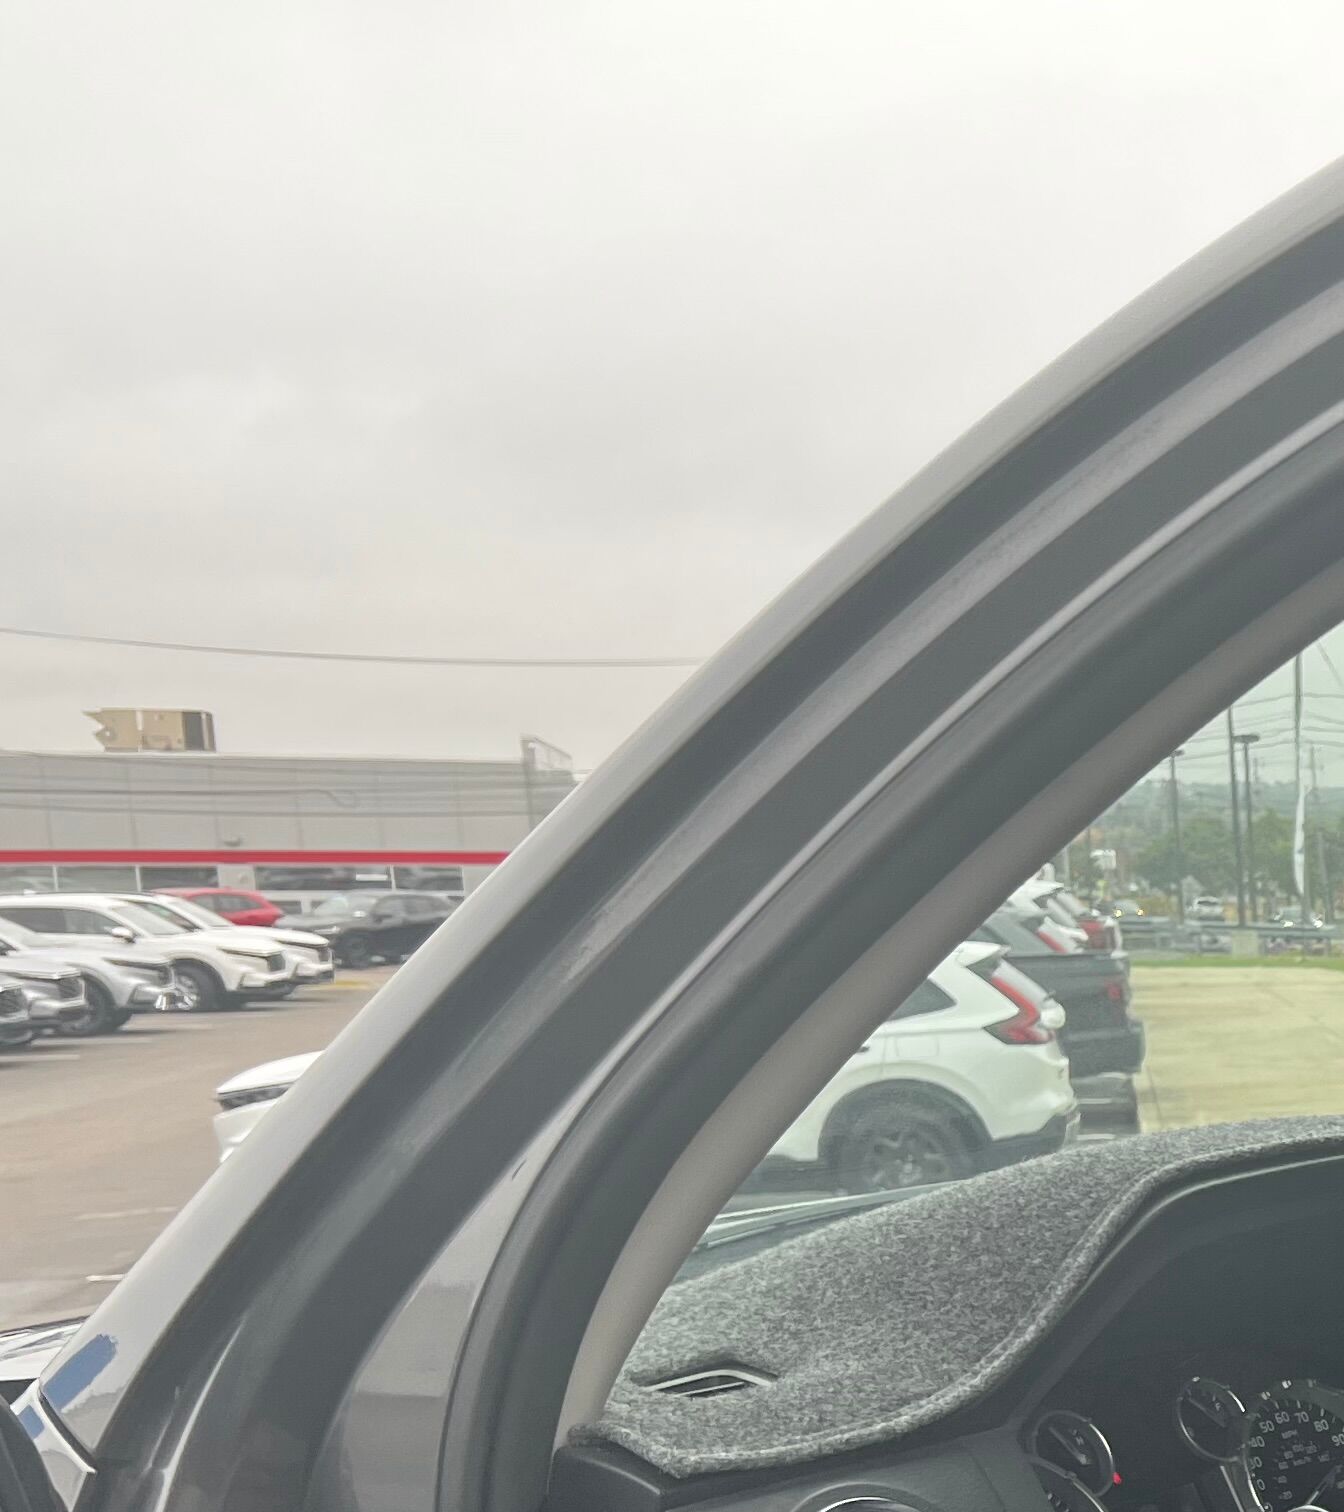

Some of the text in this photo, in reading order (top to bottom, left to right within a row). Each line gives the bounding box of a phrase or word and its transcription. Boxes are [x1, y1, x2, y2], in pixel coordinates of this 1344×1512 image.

[1274, 1411, 1290, 1424] 60
[1294, 1411, 1309, 1423] 70
[1259, 1421, 1275, 1433] 50
[1314, 1419, 1329, 1432] 80
